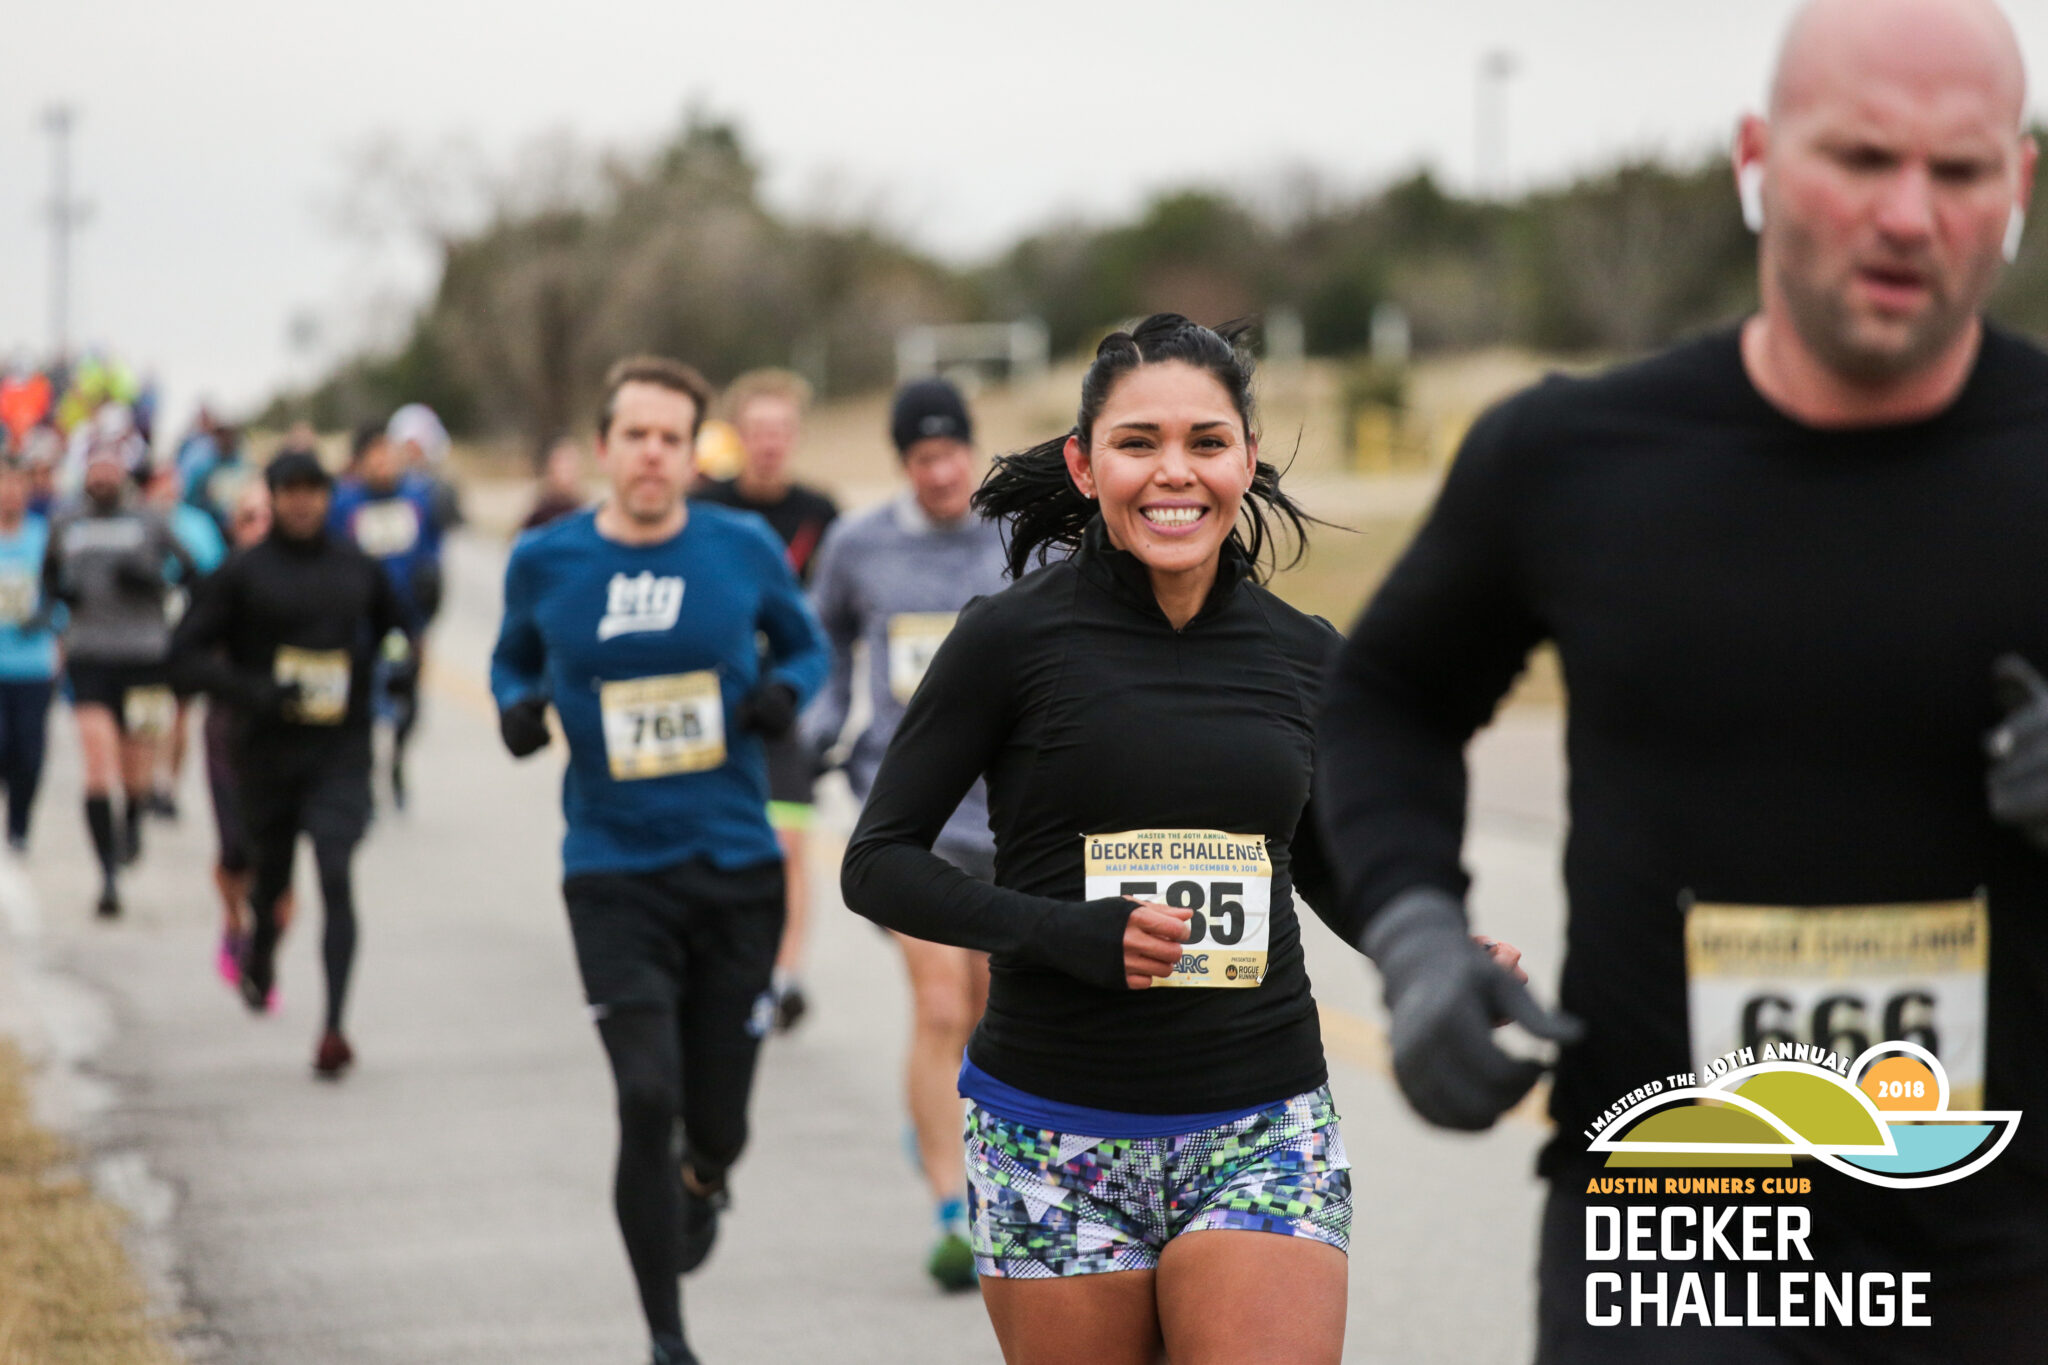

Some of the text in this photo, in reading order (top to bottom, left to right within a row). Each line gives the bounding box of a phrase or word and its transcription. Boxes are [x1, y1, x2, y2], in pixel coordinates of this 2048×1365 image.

[1091, 842, 1266, 861] DECKER CHALLENGE
[1189, 864, 1230, 872] DECEMBER
[1120, 880, 1245, 946] 85
